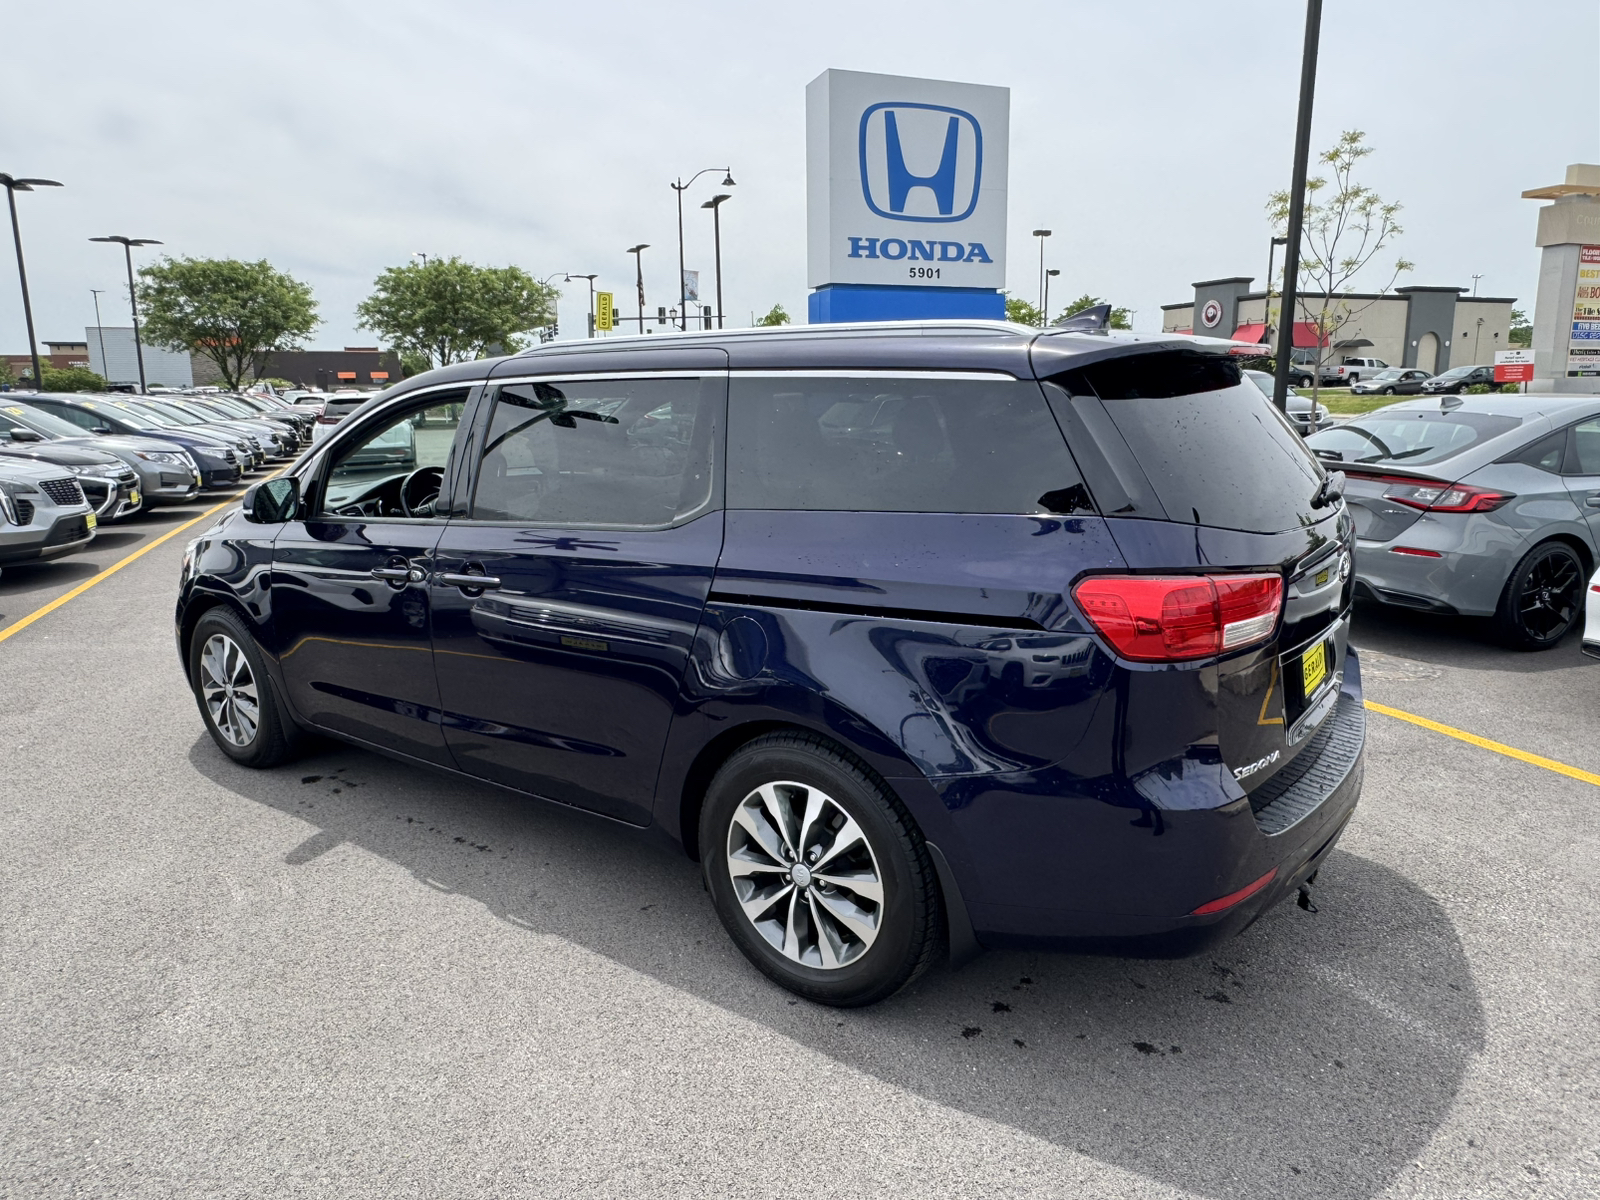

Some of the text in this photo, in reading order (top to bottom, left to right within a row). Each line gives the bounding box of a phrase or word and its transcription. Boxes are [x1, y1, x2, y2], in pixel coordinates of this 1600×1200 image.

[848, 237, 993, 263] HONDA
[909, 267, 940, 279] 5901
[1305, 652, 1322, 680] GERALD
[1233, 750, 1280, 781] SEDONA
